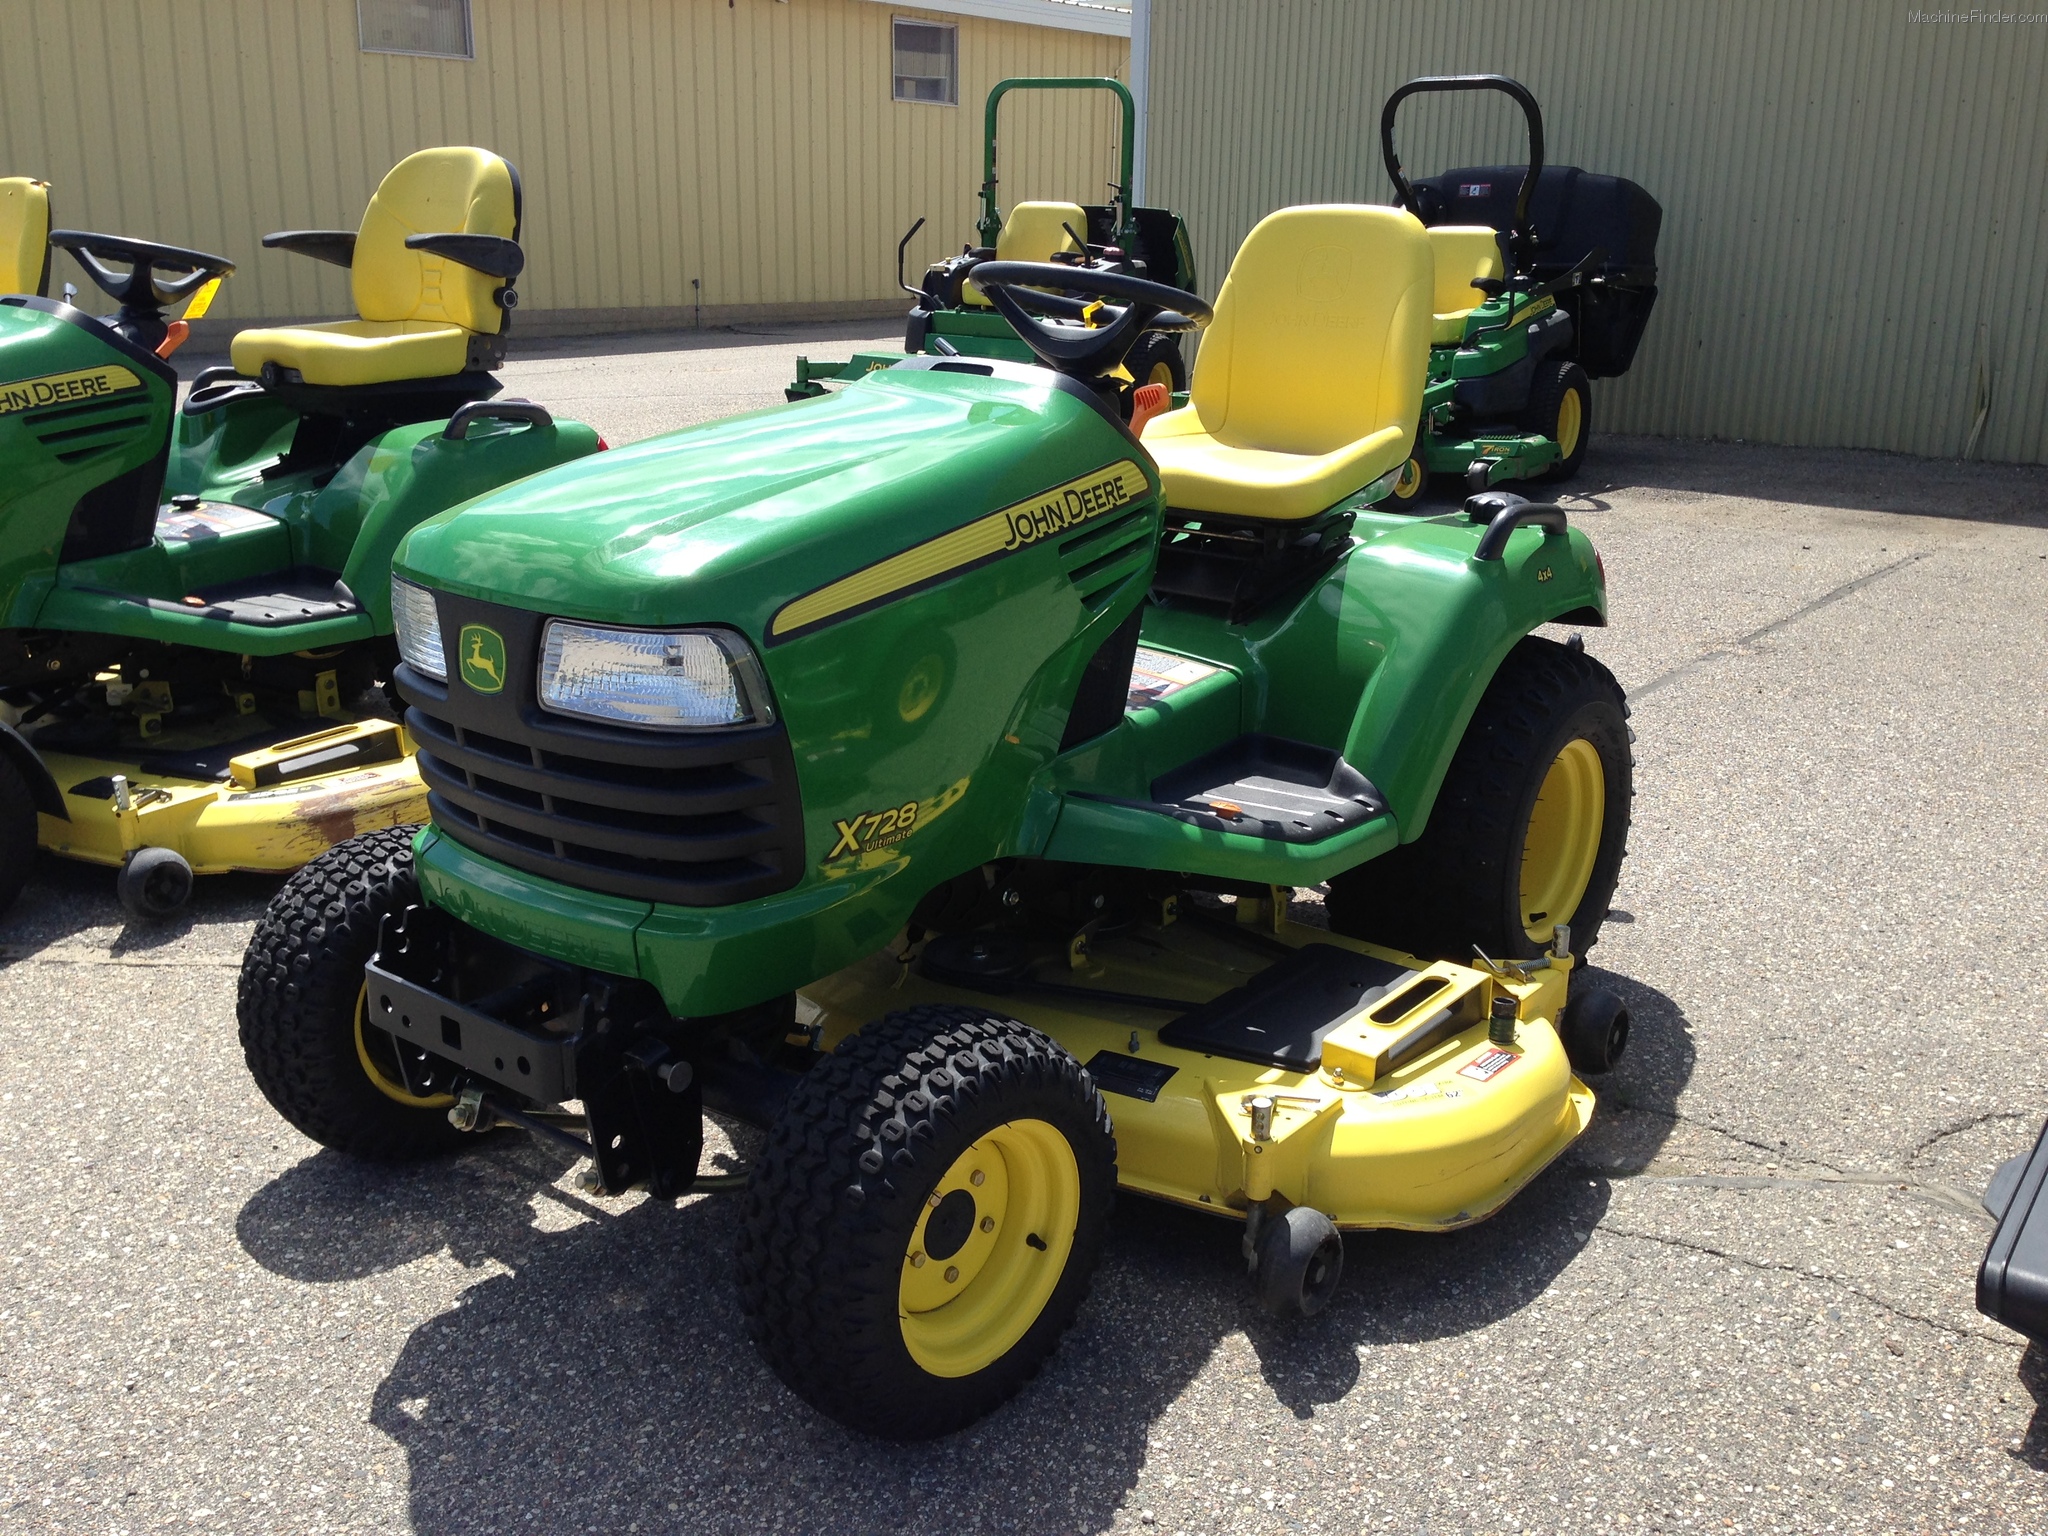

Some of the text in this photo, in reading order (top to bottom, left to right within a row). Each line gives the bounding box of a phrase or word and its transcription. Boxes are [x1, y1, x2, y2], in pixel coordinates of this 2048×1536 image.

[0, 374, 111, 410] HN DEERE
[1005, 476, 1127, 546] JOHN DEERE
[828, 801, 918, 859] X728
[865, 828, 913, 853] Ultimate
